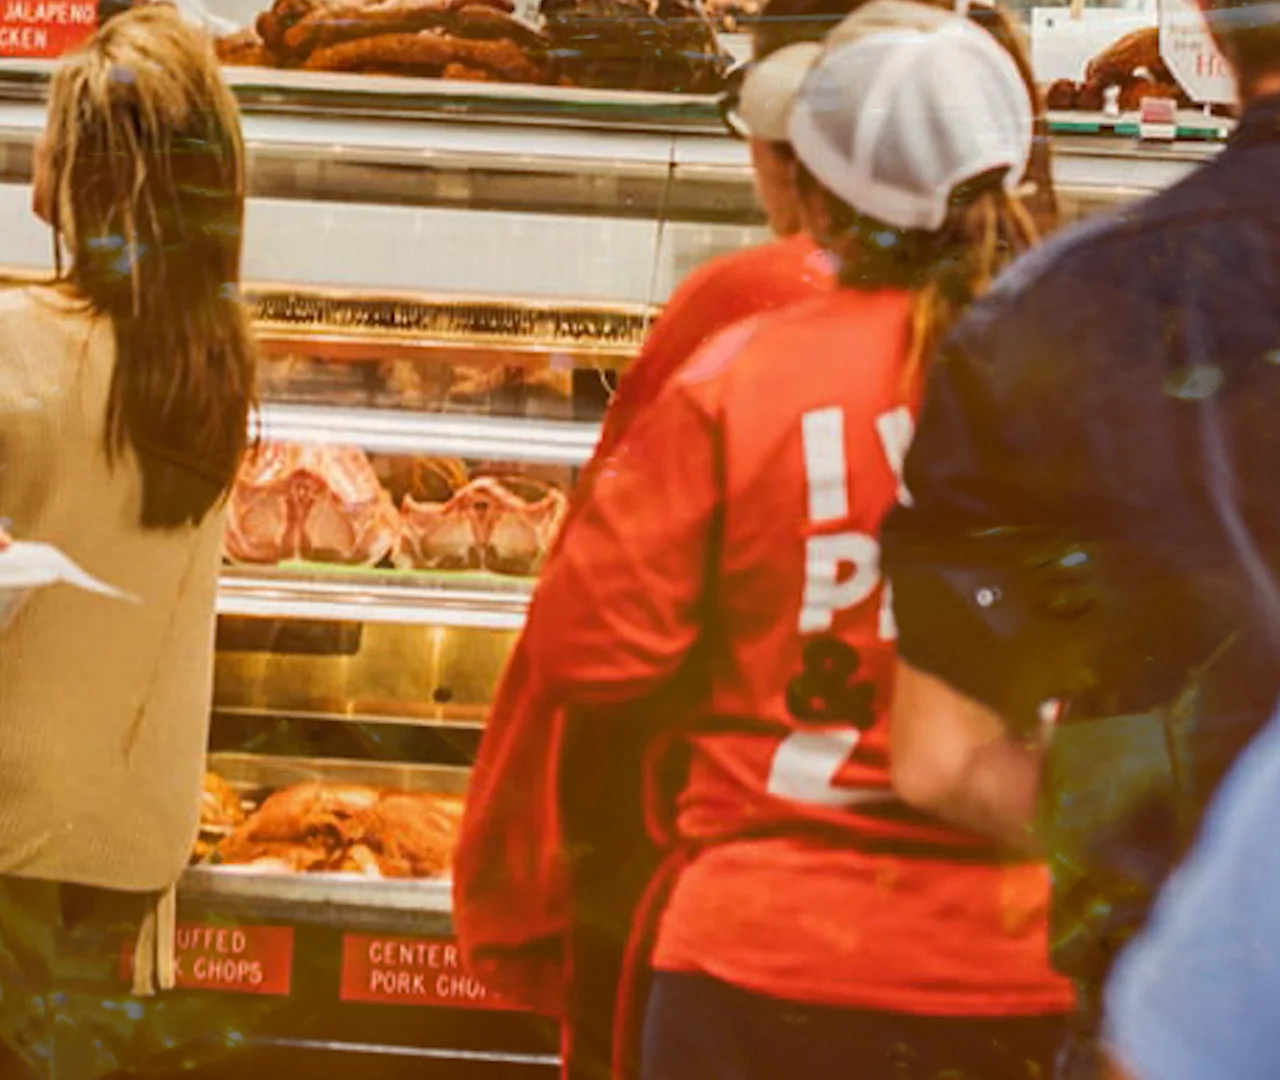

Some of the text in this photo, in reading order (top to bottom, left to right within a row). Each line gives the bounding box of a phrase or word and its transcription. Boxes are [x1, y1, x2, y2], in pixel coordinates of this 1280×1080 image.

[4, 0, 96, 25] JALAPENO
[176, 928, 246, 954] UFFED
[369, 940, 458, 968] CENTER
[193, 956, 263, 986] CHOPS
[370, 969, 487, 1000] PORK CHO
